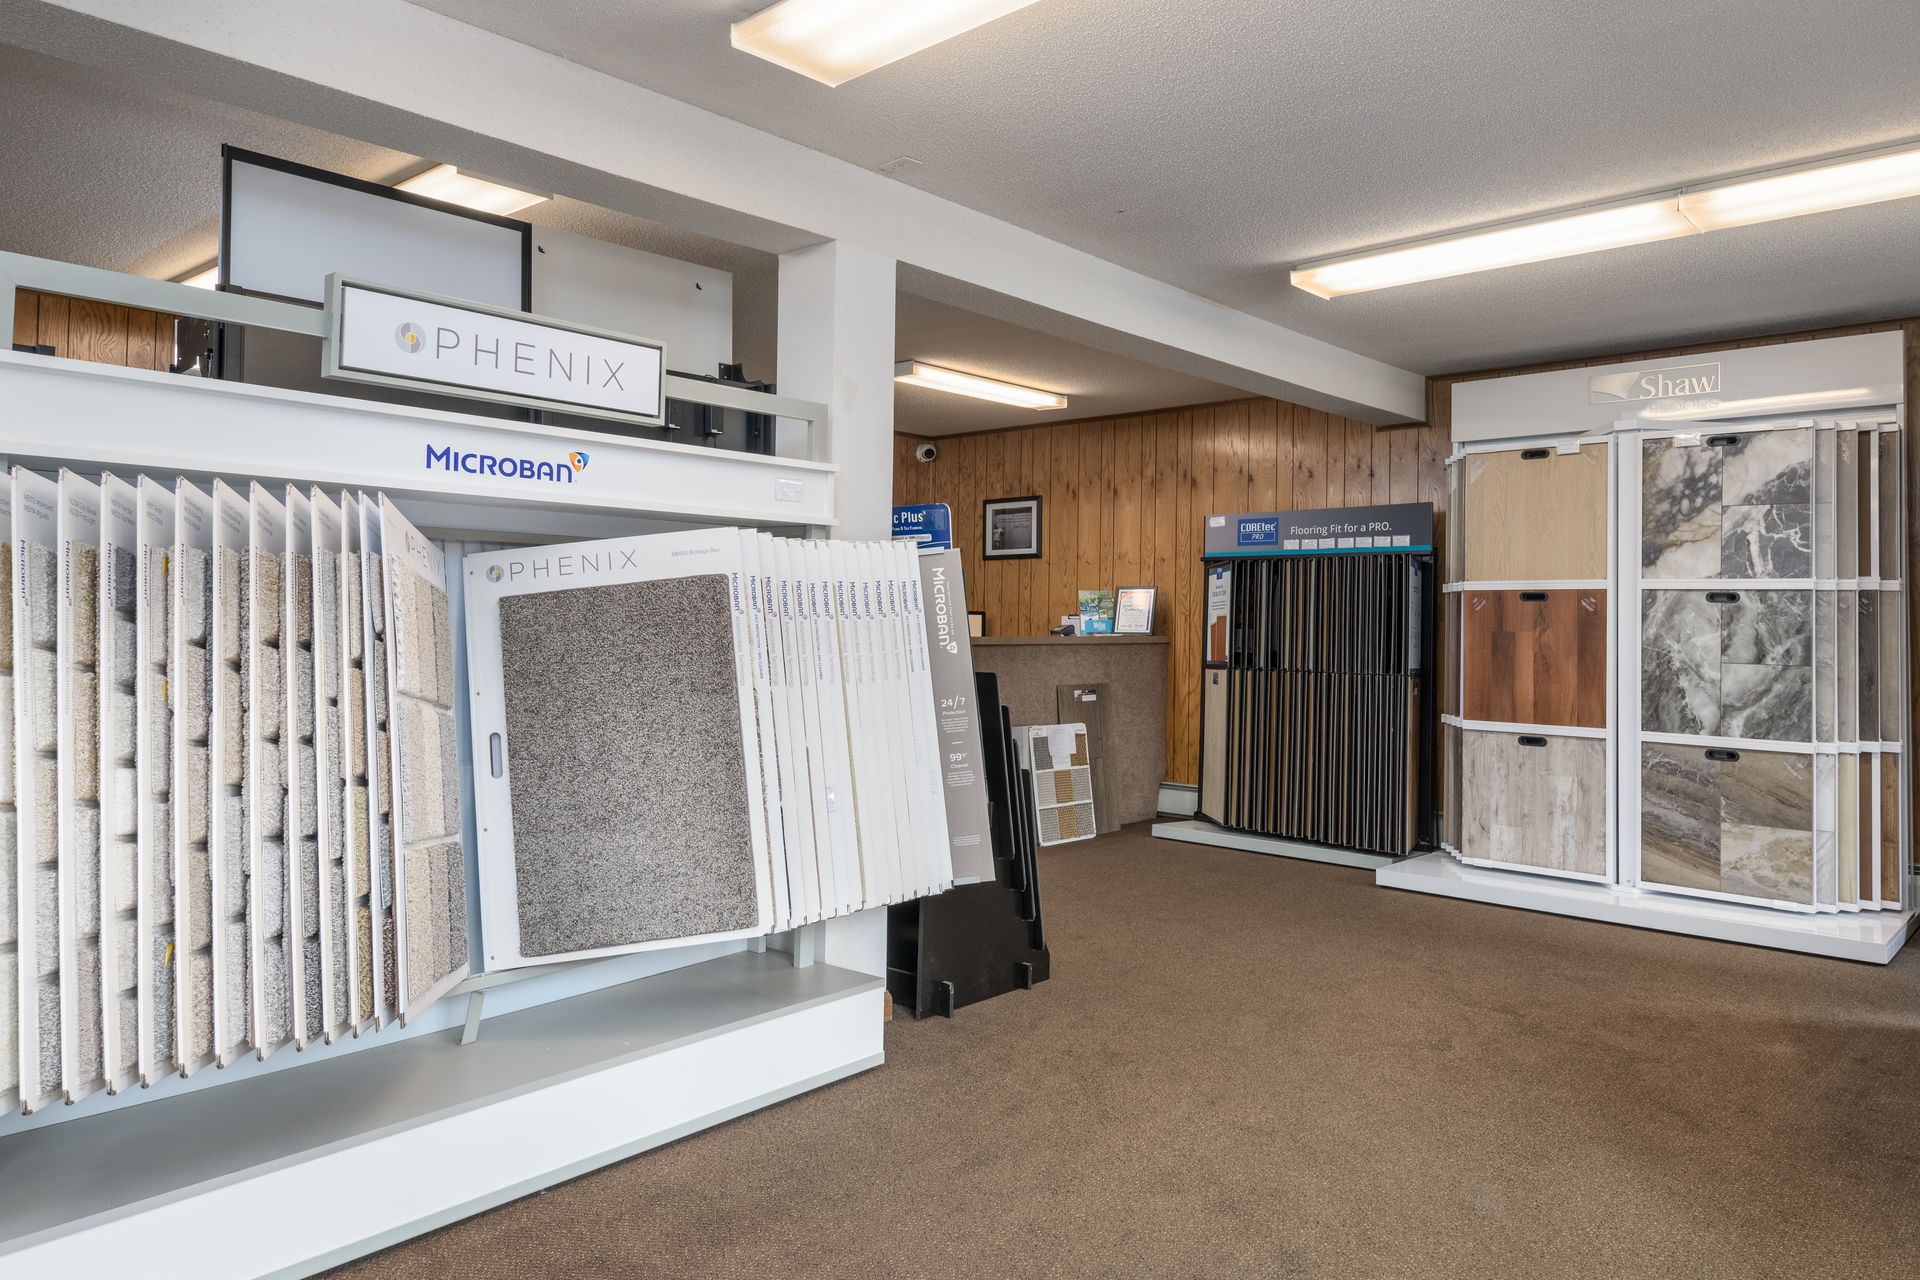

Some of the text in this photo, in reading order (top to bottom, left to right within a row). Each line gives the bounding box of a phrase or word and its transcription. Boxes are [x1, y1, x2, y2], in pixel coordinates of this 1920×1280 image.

[436, 327, 625, 391] PHENIX
[1640, 373, 1715, 399] Shaw
[426, 443, 573, 483] MICROBAN
[901, 511, 924, 524] Plus
[1240, 522, 1276, 533] COREtec
[1290, 521, 1392, 536] Flooring Fit for a PRO.
[509, 549, 638, 581] PHENIX
[731, 572, 740, 611] MICROBAN
[750, 575, 758, 610] MICROBAN
[765, 576, 774, 614] MICROBAN
[781, 580, 790, 617] MICROBAN
[796, 580, 804, 617] MICROBAN
[810, 583, 818, 615] MICROBAN
[822, 581, 831, 617] MICROBAN
[837, 580, 845, 616] MICROBAN
[850, 581, 858, 617] MICROBAN
[863, 582, 871, 617] MICROBAN
[876, 580, 884, 615] MICROBAN
[888, 580, 896, 614] MICROBAN
[931, 567, 950, 647] MICROBAN
[941, 694, 966, 710] 24/7
